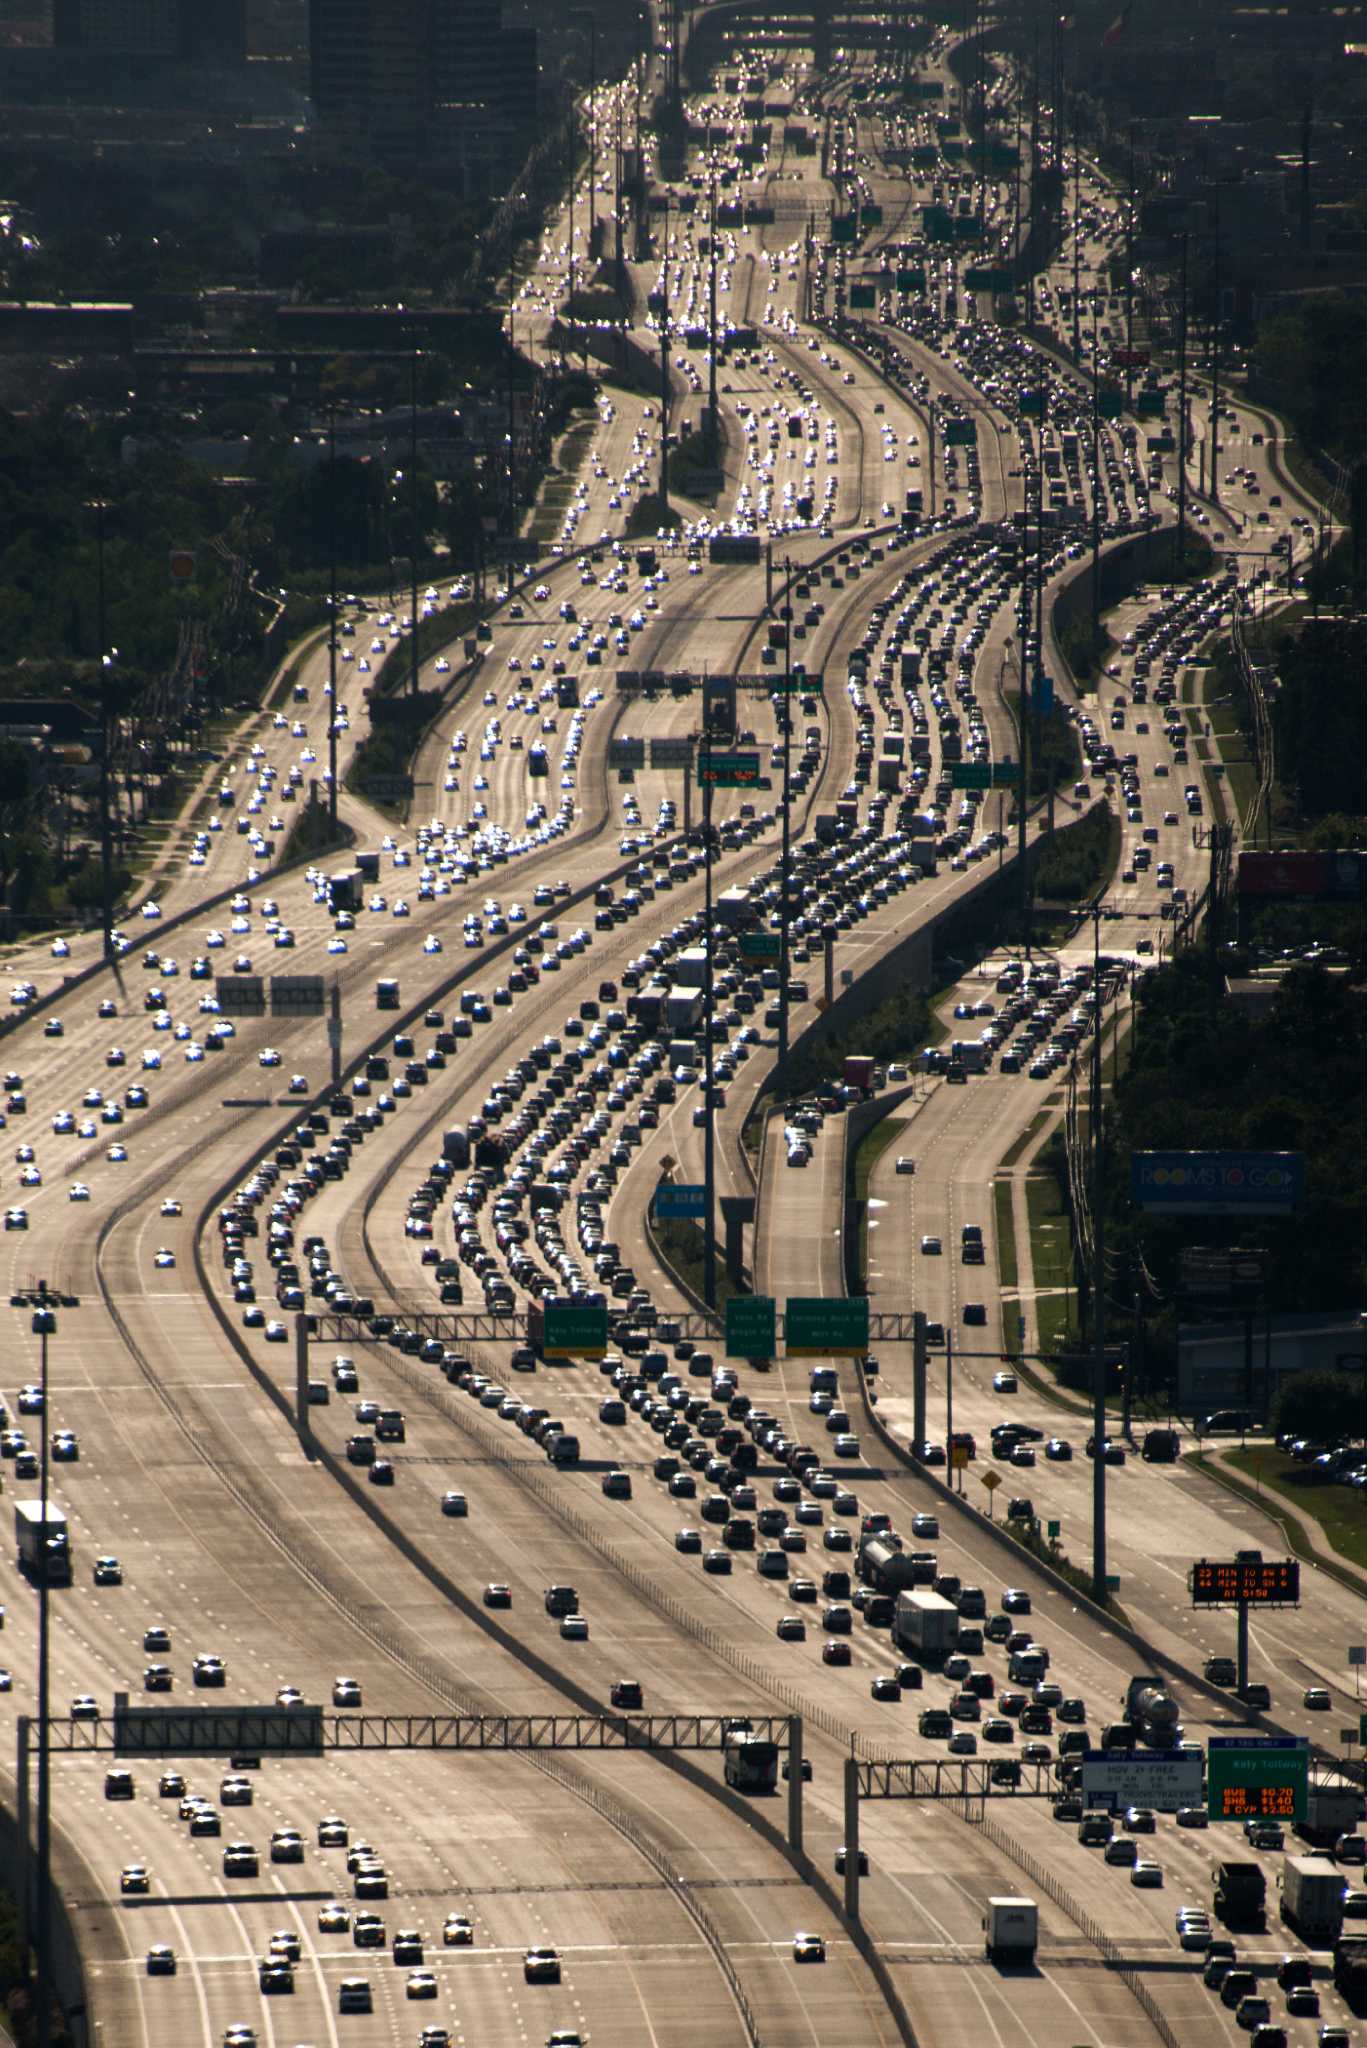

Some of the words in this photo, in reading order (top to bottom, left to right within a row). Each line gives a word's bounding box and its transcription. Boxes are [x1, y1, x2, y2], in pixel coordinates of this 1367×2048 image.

[1141, 1167, 1216, 1186] ROOMS
[1221, 1167, 1244, 1186] TO
[1248, 1167, 1284, 1186] GO
[1217, 1567, 1237, 1577] MIN
[1243, 1567, 1256, 1577] TO
[1217, 1578, 1237, 1588] MIN
[1243, 1578, 1256, 1588] TO
[1149, 1765, 1176, 1773] FREE
[1233, 1759, 1257, 1770] Katy
[1263, 1759, 1303, 1770] Tollway
[1261, 1787, 1293, 1796] $0.70
[1261, 1796, 1292, 1805] $1.40
[1234, 1805, 1257, 1815] CYP
